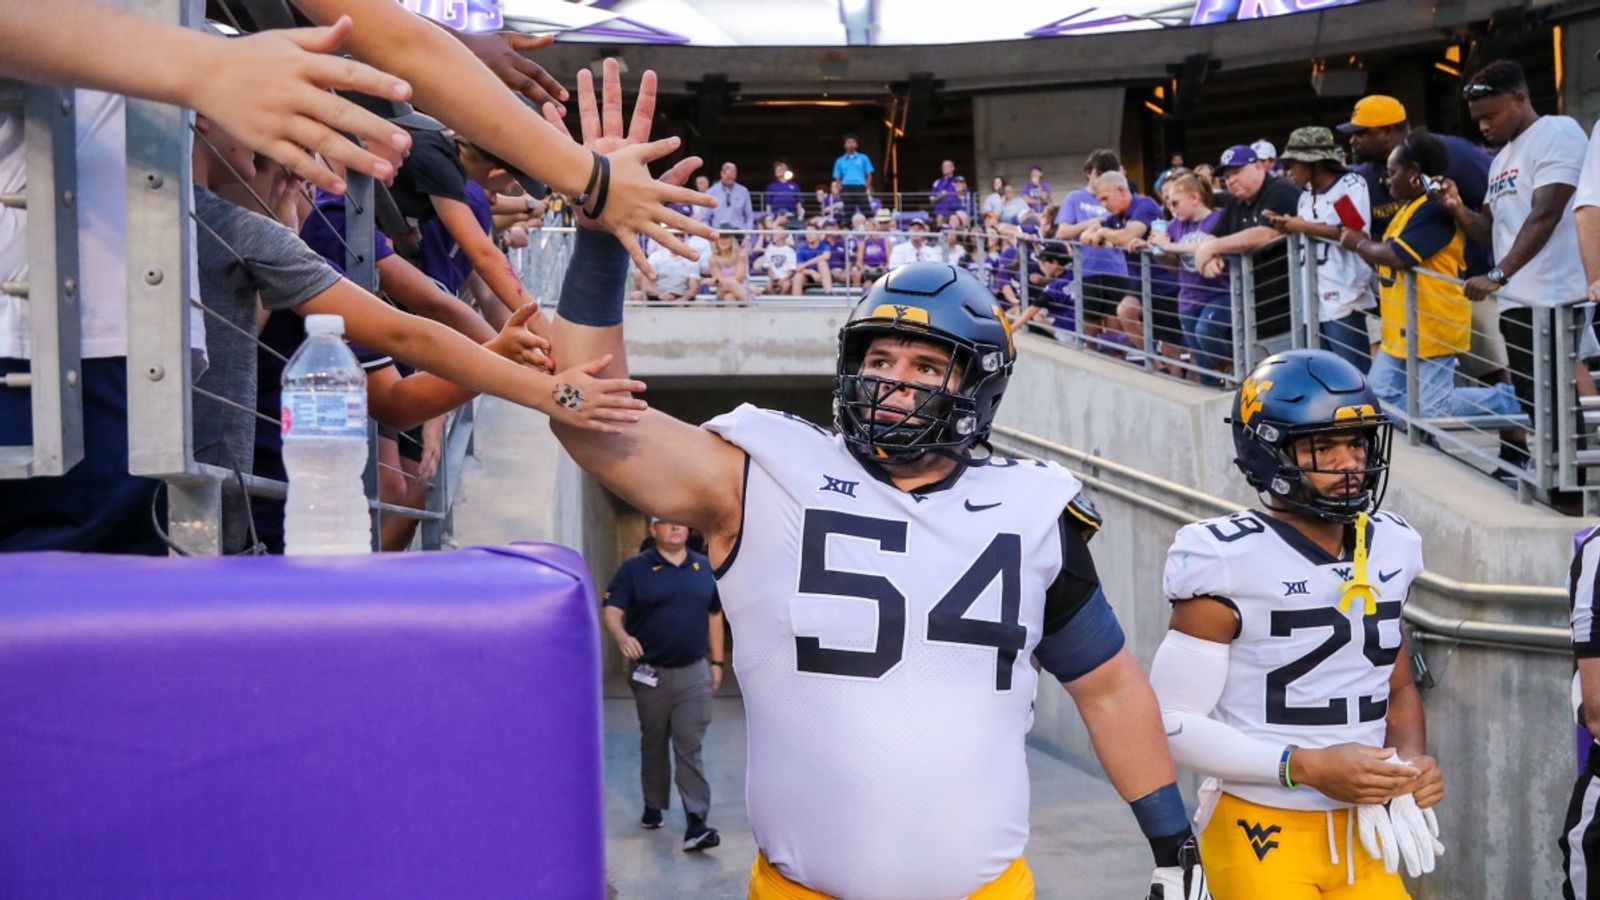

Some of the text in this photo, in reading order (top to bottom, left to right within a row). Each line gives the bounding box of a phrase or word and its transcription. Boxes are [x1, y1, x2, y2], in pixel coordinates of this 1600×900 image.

[819, 474, 860, 498] XII
[795, 507, 1028, 691] 54
[1281, 580, 1311, 596] XII
[1265, 600, 1402, 726] 29
